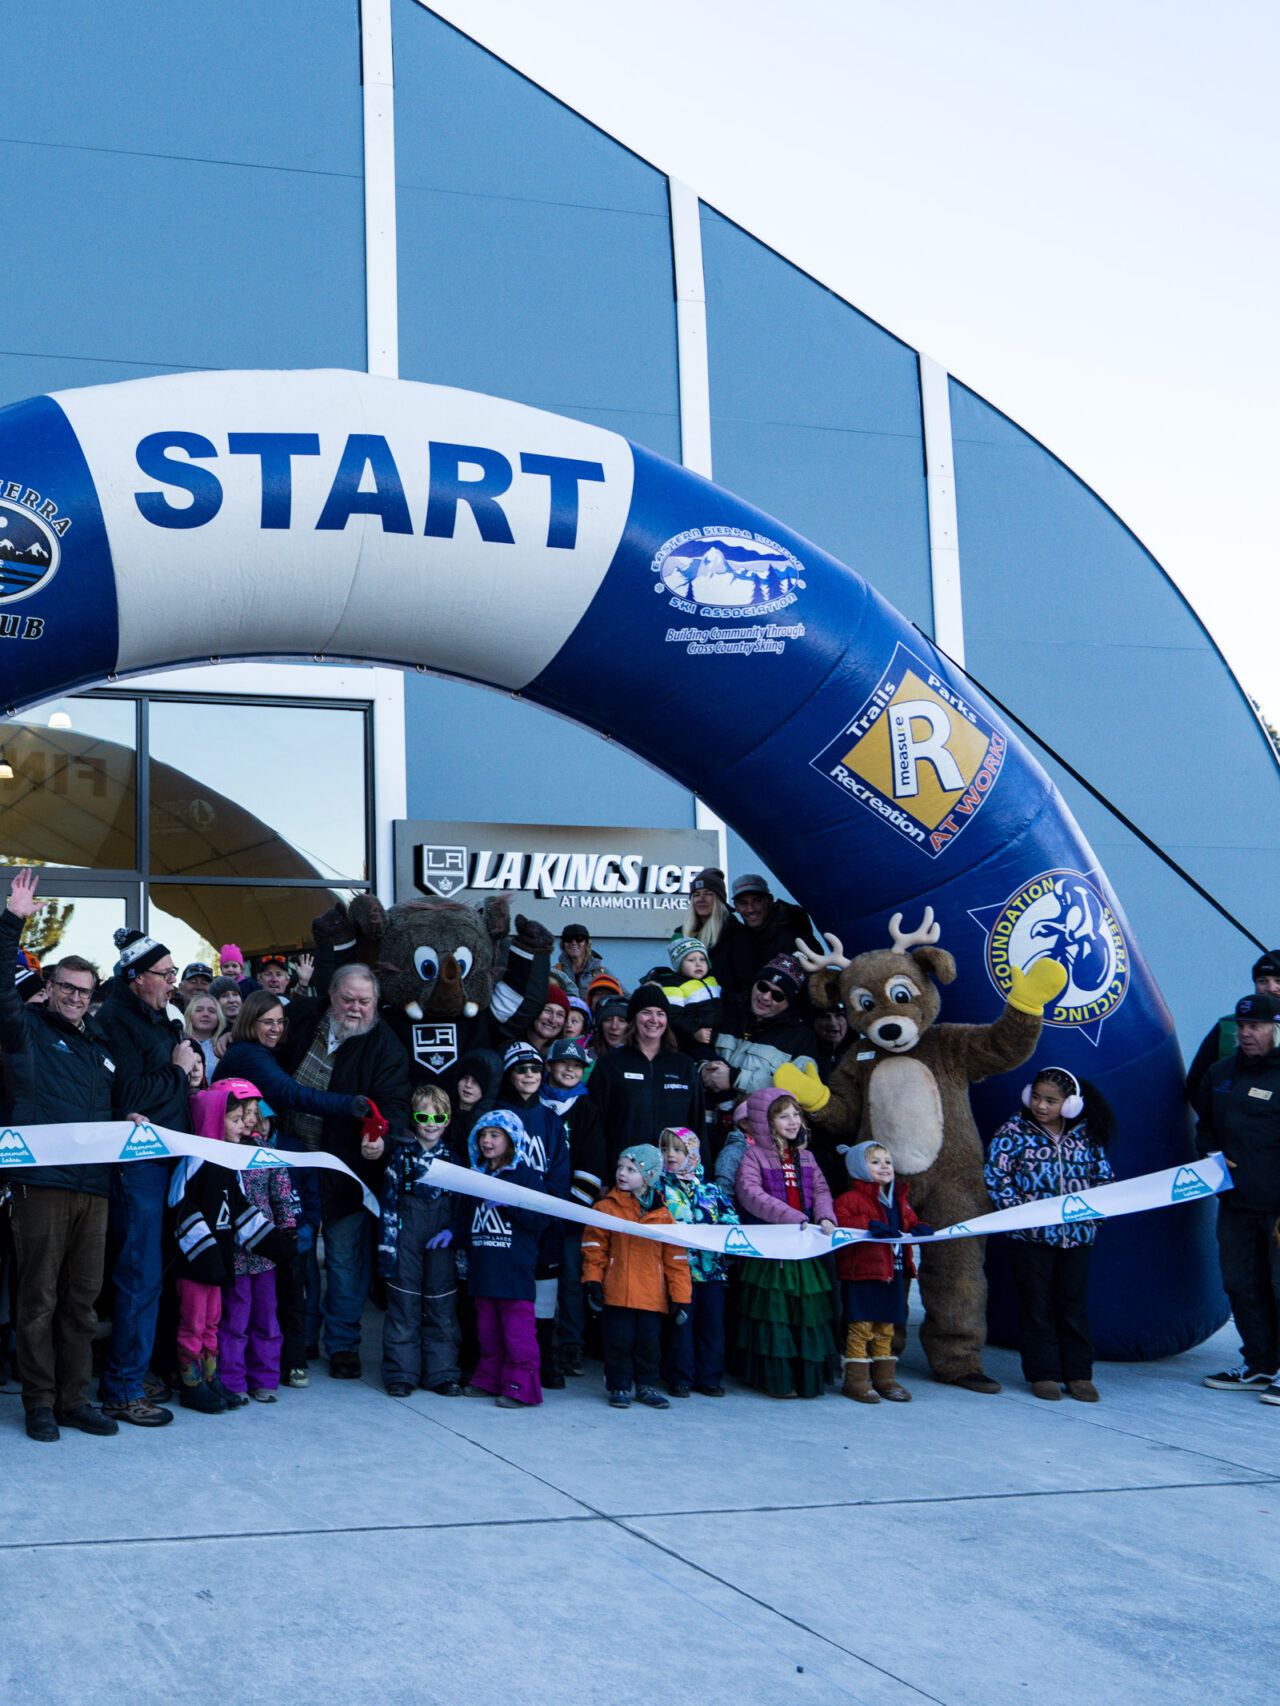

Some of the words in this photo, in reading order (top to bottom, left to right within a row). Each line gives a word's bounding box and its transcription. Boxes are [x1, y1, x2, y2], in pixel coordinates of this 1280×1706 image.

[133, 430, 606, 550] START
[651, 528, 702, 572] EASTERN
[703, 525, 753, 539] SIERRA
[669, 596, 697, 615] SKI
[700, 592, 799, 619] ASSOCIATION
[665, 628, 709, 643] Building
[709, 626, 765, 641] Community
[766, 622, 806, 640] Through
[686, 641, 715, 655] Cross
[714, 641, 756, 656] Country
[754, 638, 786, 654] Skiing
[845, 681, 896, 738] Trails
[927, 673, 978, 724] Parks
[888, 699, 967, 800] R
[897, 716, 911, 787] measure
[829, 764, 927, 843] Recreation
[928, 814, 960, 852] AT
[956, 732, 1006, 816] WORK!
[428, 852, 463, 869] LA
[471, 851, 524, 890] LA
[523, 852, 643, 898] KINGS
[561, 895, 579, 908] AT
[580, 896, 651, 909] MAMMOTH
[654, 898, 692, 910] LAKE
[991, 877, 1055, 989] FOUNDATION
[1103, 907, 1126, 973] SIERRA
[1053, 980, 1123, 1022] CYCLING
[417, 1029, 454, 1045] LA
[126, 1143, 163, 1152] Mammoth
[483, 1240, 512, 1248] HOCKEY
